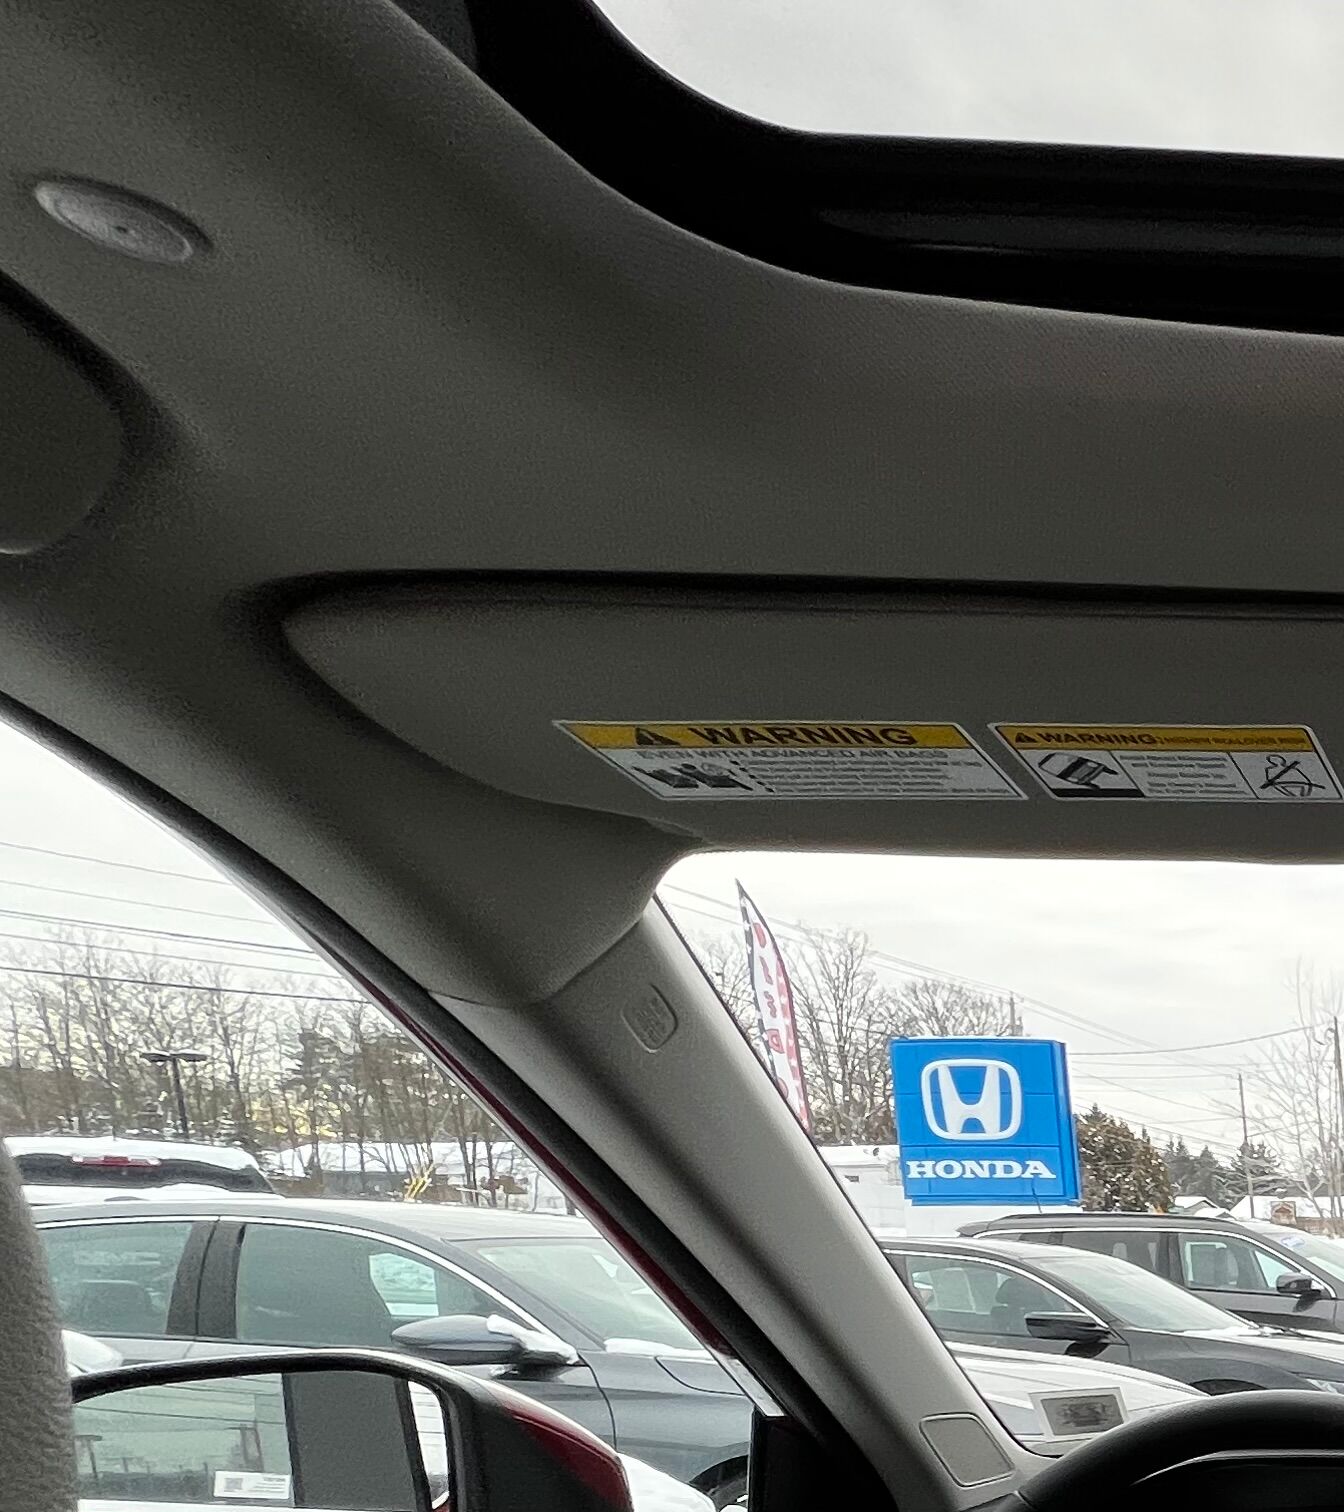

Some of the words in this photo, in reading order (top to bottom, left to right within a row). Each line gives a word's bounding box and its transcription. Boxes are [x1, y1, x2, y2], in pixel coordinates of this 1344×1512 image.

[687, 727, 918, 746] WARNING
[637, 751, 690, 759] EVEN
[697, 751, 748, 759] WITH
[751, 751, 855, 759] ADVANCED
[859, 751, 889, 759] AIR
[893, 750, 949, 759] BAGS
[905, 1159, 1057, 1180] HONDA
